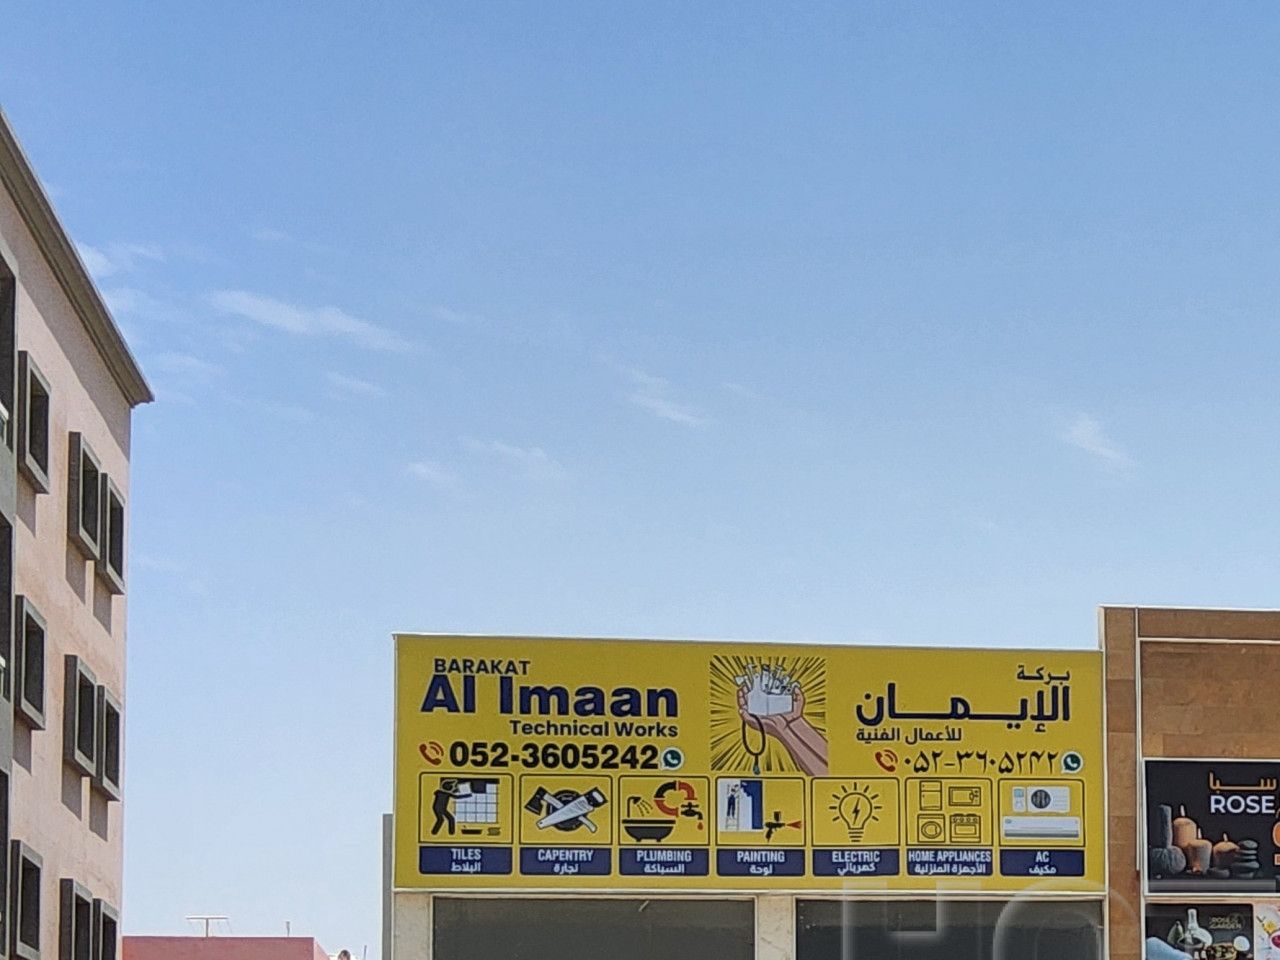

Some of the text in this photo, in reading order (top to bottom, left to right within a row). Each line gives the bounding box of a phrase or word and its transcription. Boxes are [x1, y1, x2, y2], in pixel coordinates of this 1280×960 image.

[434, 659, 530, 675] BARAKAT
[1017, 665, 1070, 684] بركة
[421, 675, 679, 717] Al Imaan
[856, 683, 1070, 732] الإيمان
[510, 720, 679, 738] Technical Works
[856, 726, 962, 745] للأعمال الفنية
[450, 741, 659, 770] 052-3605242
[1210, 795, 1276, 815] ROSE
[451, 848, 481, 860] TILES
[538, 849, 593, 862] CAPENTRY
[637, 850, 692, 863] PLUMBING
[737, 851, 785, 863] PAINTING
[832, 851, 881, 863] ELECTRIC
[908, 851, 992, 863] HOME APPLIANCES
[1035, 851, 1049, 862] AC
[451, 861, 481, 873] البلاط
[554, 862, 579, 874] نجارة
[644, 862, 685, 874] السباكة
[750, 863, 773, 876] لوحة
[914, 863, 986, 876] الأجهزة المنزلية
[1029, 864, 1057, 876] مكيف
